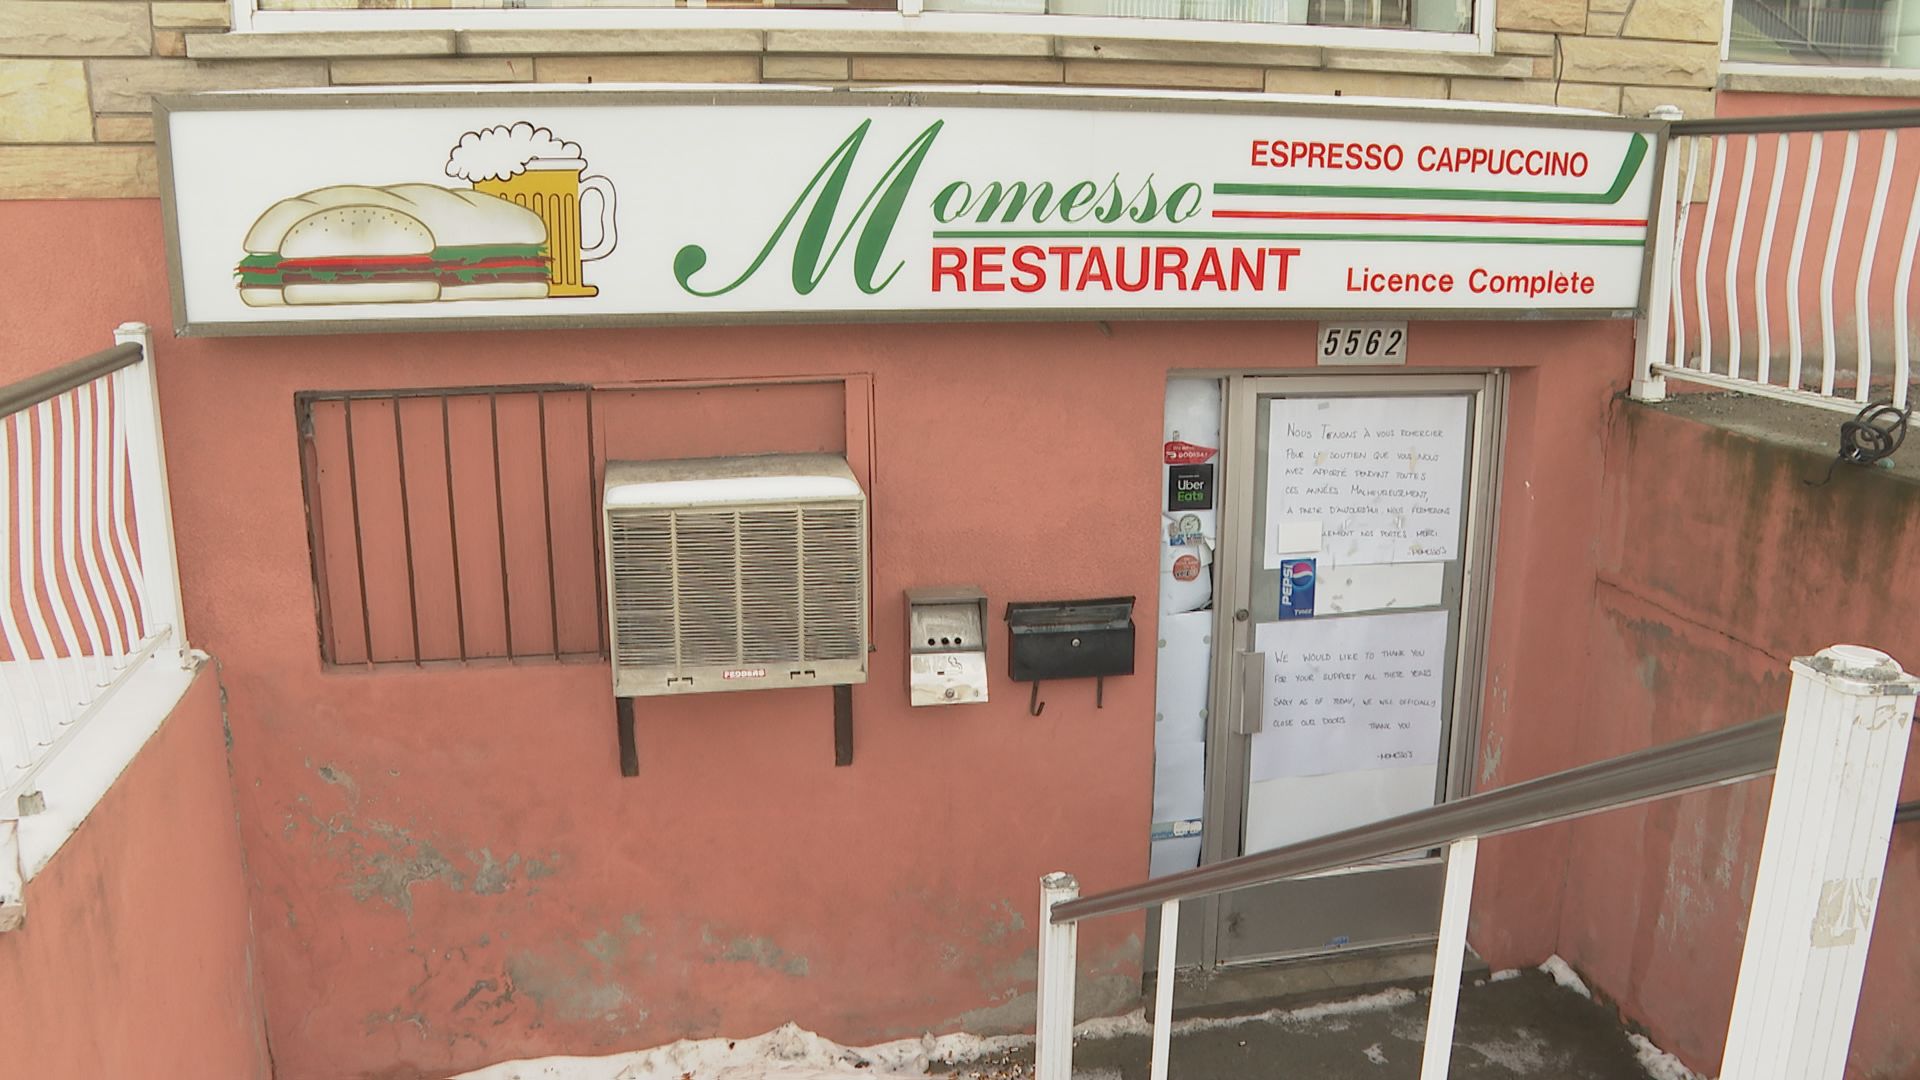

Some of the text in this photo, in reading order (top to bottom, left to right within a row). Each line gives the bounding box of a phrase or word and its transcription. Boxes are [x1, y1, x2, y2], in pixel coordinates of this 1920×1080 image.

[1251, 140, 1589, 178] ESPRESSO CAPPUCCINO
[673, 118, 1203, 298] Momesso
[931, 245, 1301, 293] RESTAURANT
[1346, 266, 1596, 298] Licence Complète
[1323, 328, 1404, 356] 5562
[1177, 479, 1204, 491] Uber
[1177, 491, 1204, 502] Eats
[1282, 563, 1293, 606] PEPSI
[1303, 652, 1332, 662] WOULD
[1339, 652, 1358, 662] LIKE
[1365, 651, 1375, 661] TO
[1381, 649, 1406, 658] THANK
[1410, 649, 1425, 657] YOU
[1295, 673, 1315, 683] YOUR
[1322, 672, 1357, 682] SUPPORT
[1364, 672, 1377, 681] ALL
[1314, 697, 1323, 706] OF
[1322, 716, 1346, 725] DOORS
[1368, 722, 1392, 730] THANK
[1398, 721, 1411, 730] YOU
